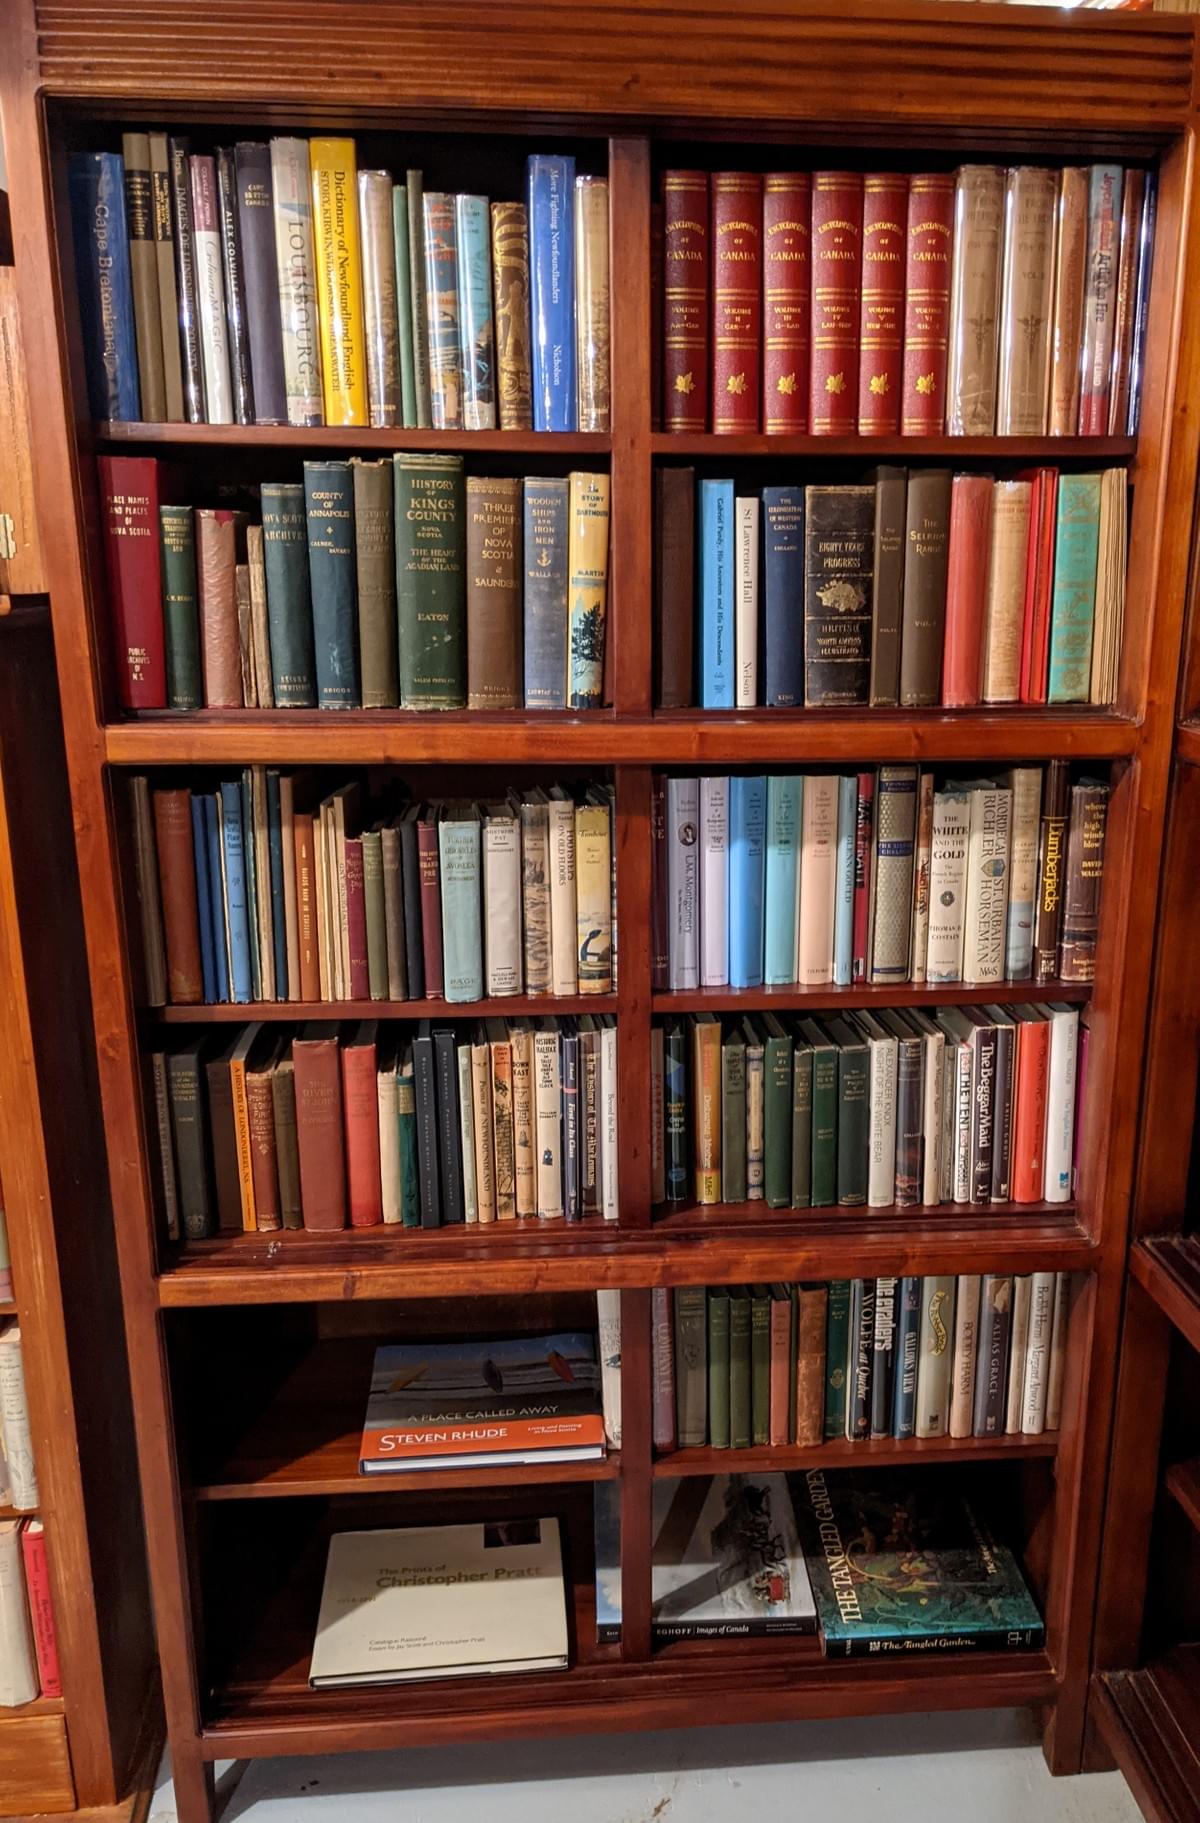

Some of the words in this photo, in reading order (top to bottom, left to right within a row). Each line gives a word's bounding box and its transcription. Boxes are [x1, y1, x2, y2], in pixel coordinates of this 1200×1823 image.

[334, 171, 347, 238] Dictionary
[550, 194, 560, 230] Fighting
[94, 204, 110, 250] Cape
[225, 210, 235, 238] ALEX
[338, 241, 349, 253] of
[667, 252, 703, 261] CANADA
[720, 252, 755, 261] CANADA
[771, 253, 806, 261] CANADA
[820, 251, 855, 260] CANADA
[866, 253, 900, 261] CANADA
[913, 253, 947, 262] CANADA
[551, 232, 561, 304] Newfoundlanders
[287, 221, 313, 376] LOUISBOURG
[338, 256, 353, 341] Newfoundland
[341, 345, 355, 391] English
[411, 479, 455, 489] HISTORY
[312, 492, 343, 500] COUNTY
[411, 498, 455, 510] KINGS
[407, 511, 456, 522] COUNTY
[483, 503, 515, 513] THREE
[743, 508, 753, 520] St
[492, 527, 506, 536] OF
[534, 526, 555, 534] IRON
[536, 536, 554, 545] MEN
[411, 548, 428, 556] THE
[485, 538, 513, 548] NOVA
[743, 525, 753, 577] Lawrence
[743, 580, 753, 604] Hall
[418, 613, 449, 621] EATON
[743, 662, 752, 696] Nelson
[933, 826, 968, 835] WHITE
[981, 795, 996, 858] RICHLER
[995, 794, 1009, 856] MORDECAI
[1084, 822, 1100, 831] high
[934, 851, 964, 859] GOLD
[1044, 822, 1064, 912] Lumberjacks
[977, 879, 992, 962] HORSEMAN
[982, 1042, 994, 1068] The
[977, 1068, 992, 1114] Beggar
[979, 1114, 991, 1148] Maid
[859, 1292, 873, 1350] WOLFE
[874, 1300, 896, 1351] evaders
[408, 1415, 418, 1423] A
[422, 1412, 462, 1422] PLACE
[466, 1408, 515, 1420] CALLED
[519, 1405, 559, 1415] AWAY
[379, 1431, 447, 1452] STEVEN
[451, 1428, 508, 1441] RHUDE
[819, 1522, 853, 1589] TANGLED
[376, 1571, 488, 1588] Christopher
[494, 1566, 543, 1580] Pratt
[836, 1588, 862, 1624] THE
